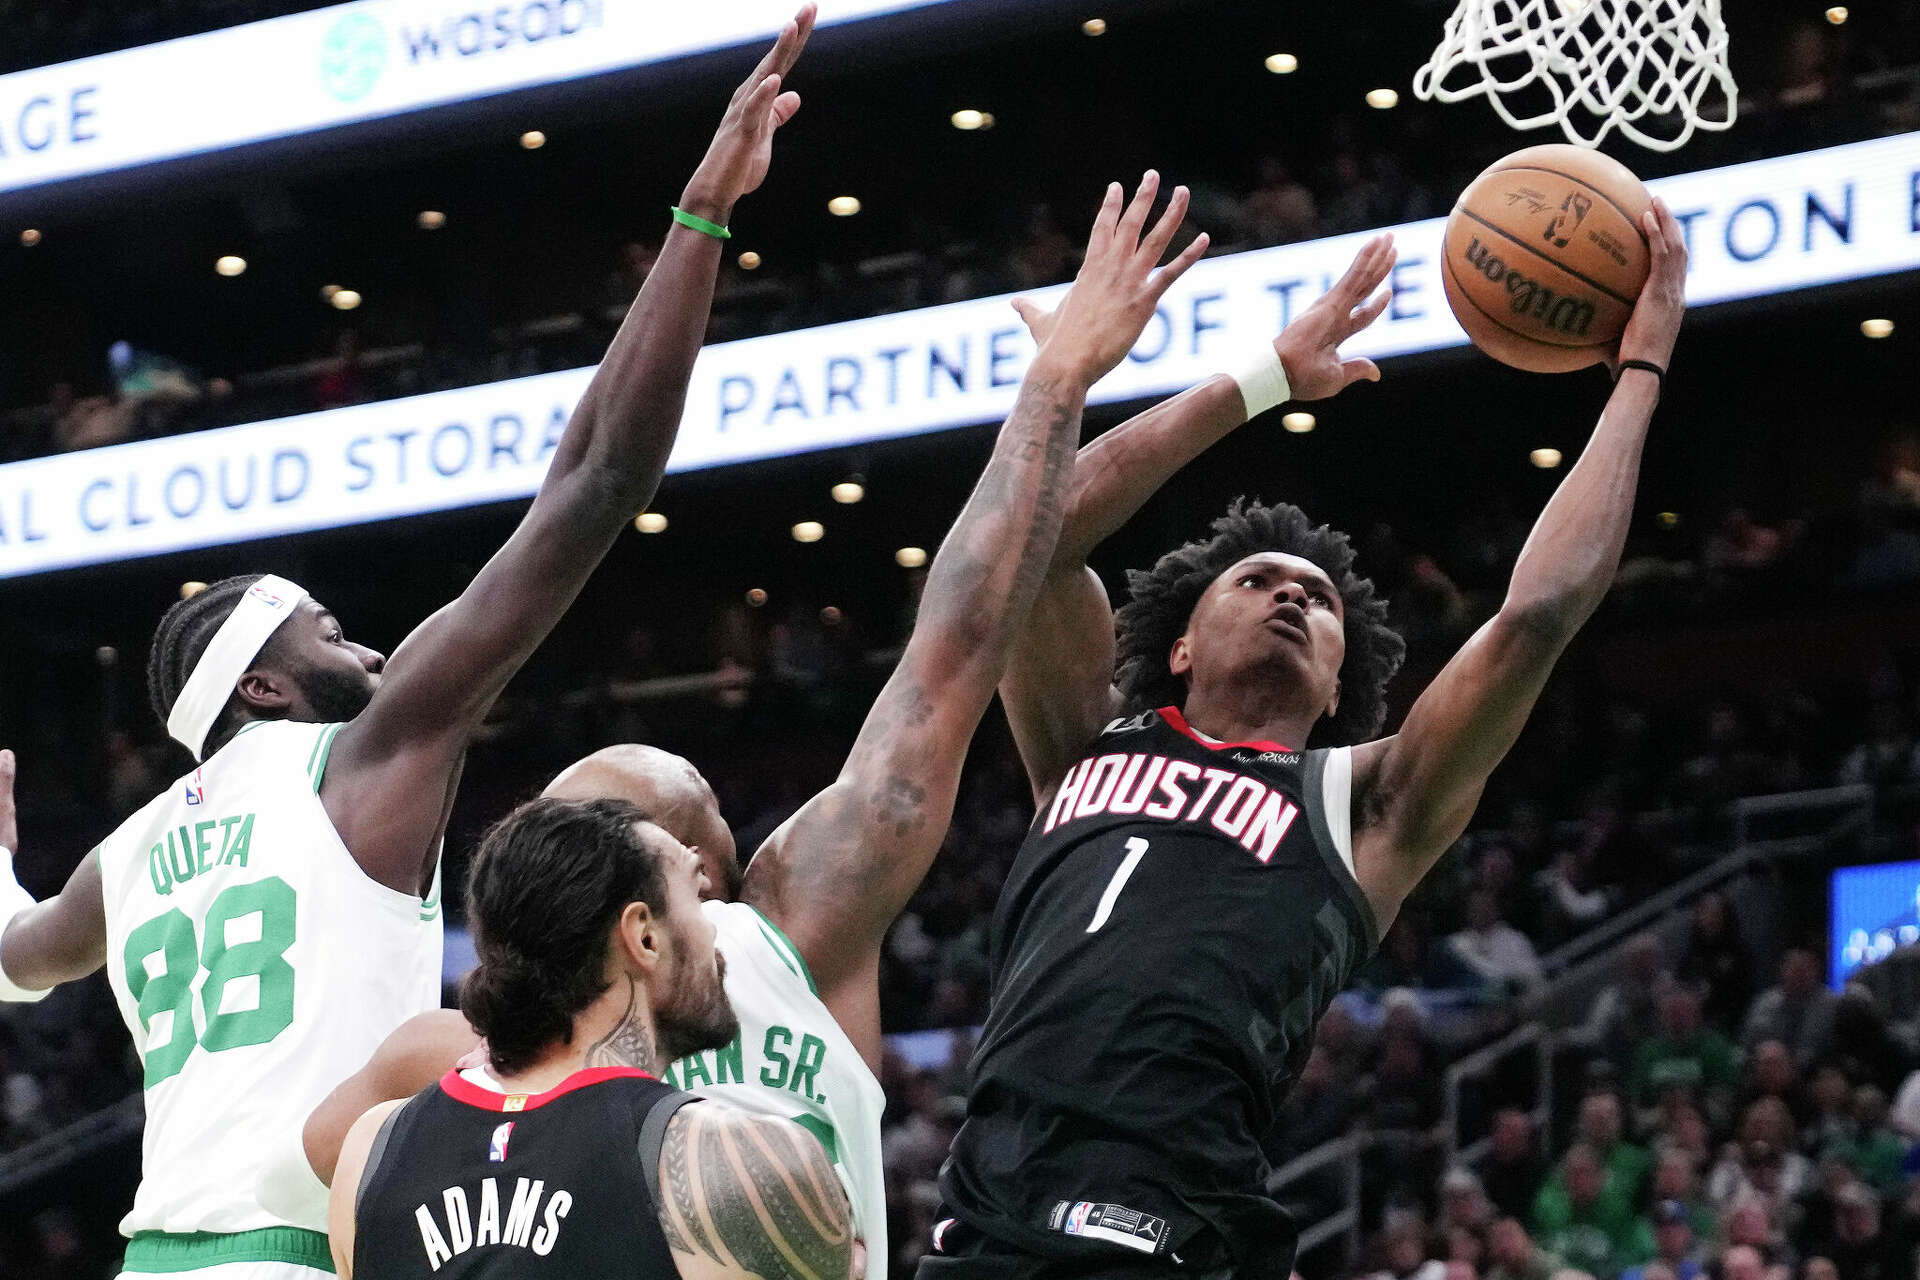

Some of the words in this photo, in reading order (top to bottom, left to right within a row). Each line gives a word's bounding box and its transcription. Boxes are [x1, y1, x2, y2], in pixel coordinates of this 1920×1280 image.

[78, 448, 311, 532] CLOUD
[345, 408, 568, 491] STORA
[717, 327, 1022, 433] PARTNE
[1266, 256, 1427, 332] TE
[150, 813, 256, 895] QUETA
[1043, 752, 1299, 865] HOUSTON
[1086, 836, 1149, 934] 1
[123, 875, 297, 1091] 88
[760, 1025, 827, 1105] SR.
[414, 1176, 573, 1272] ADAMS
